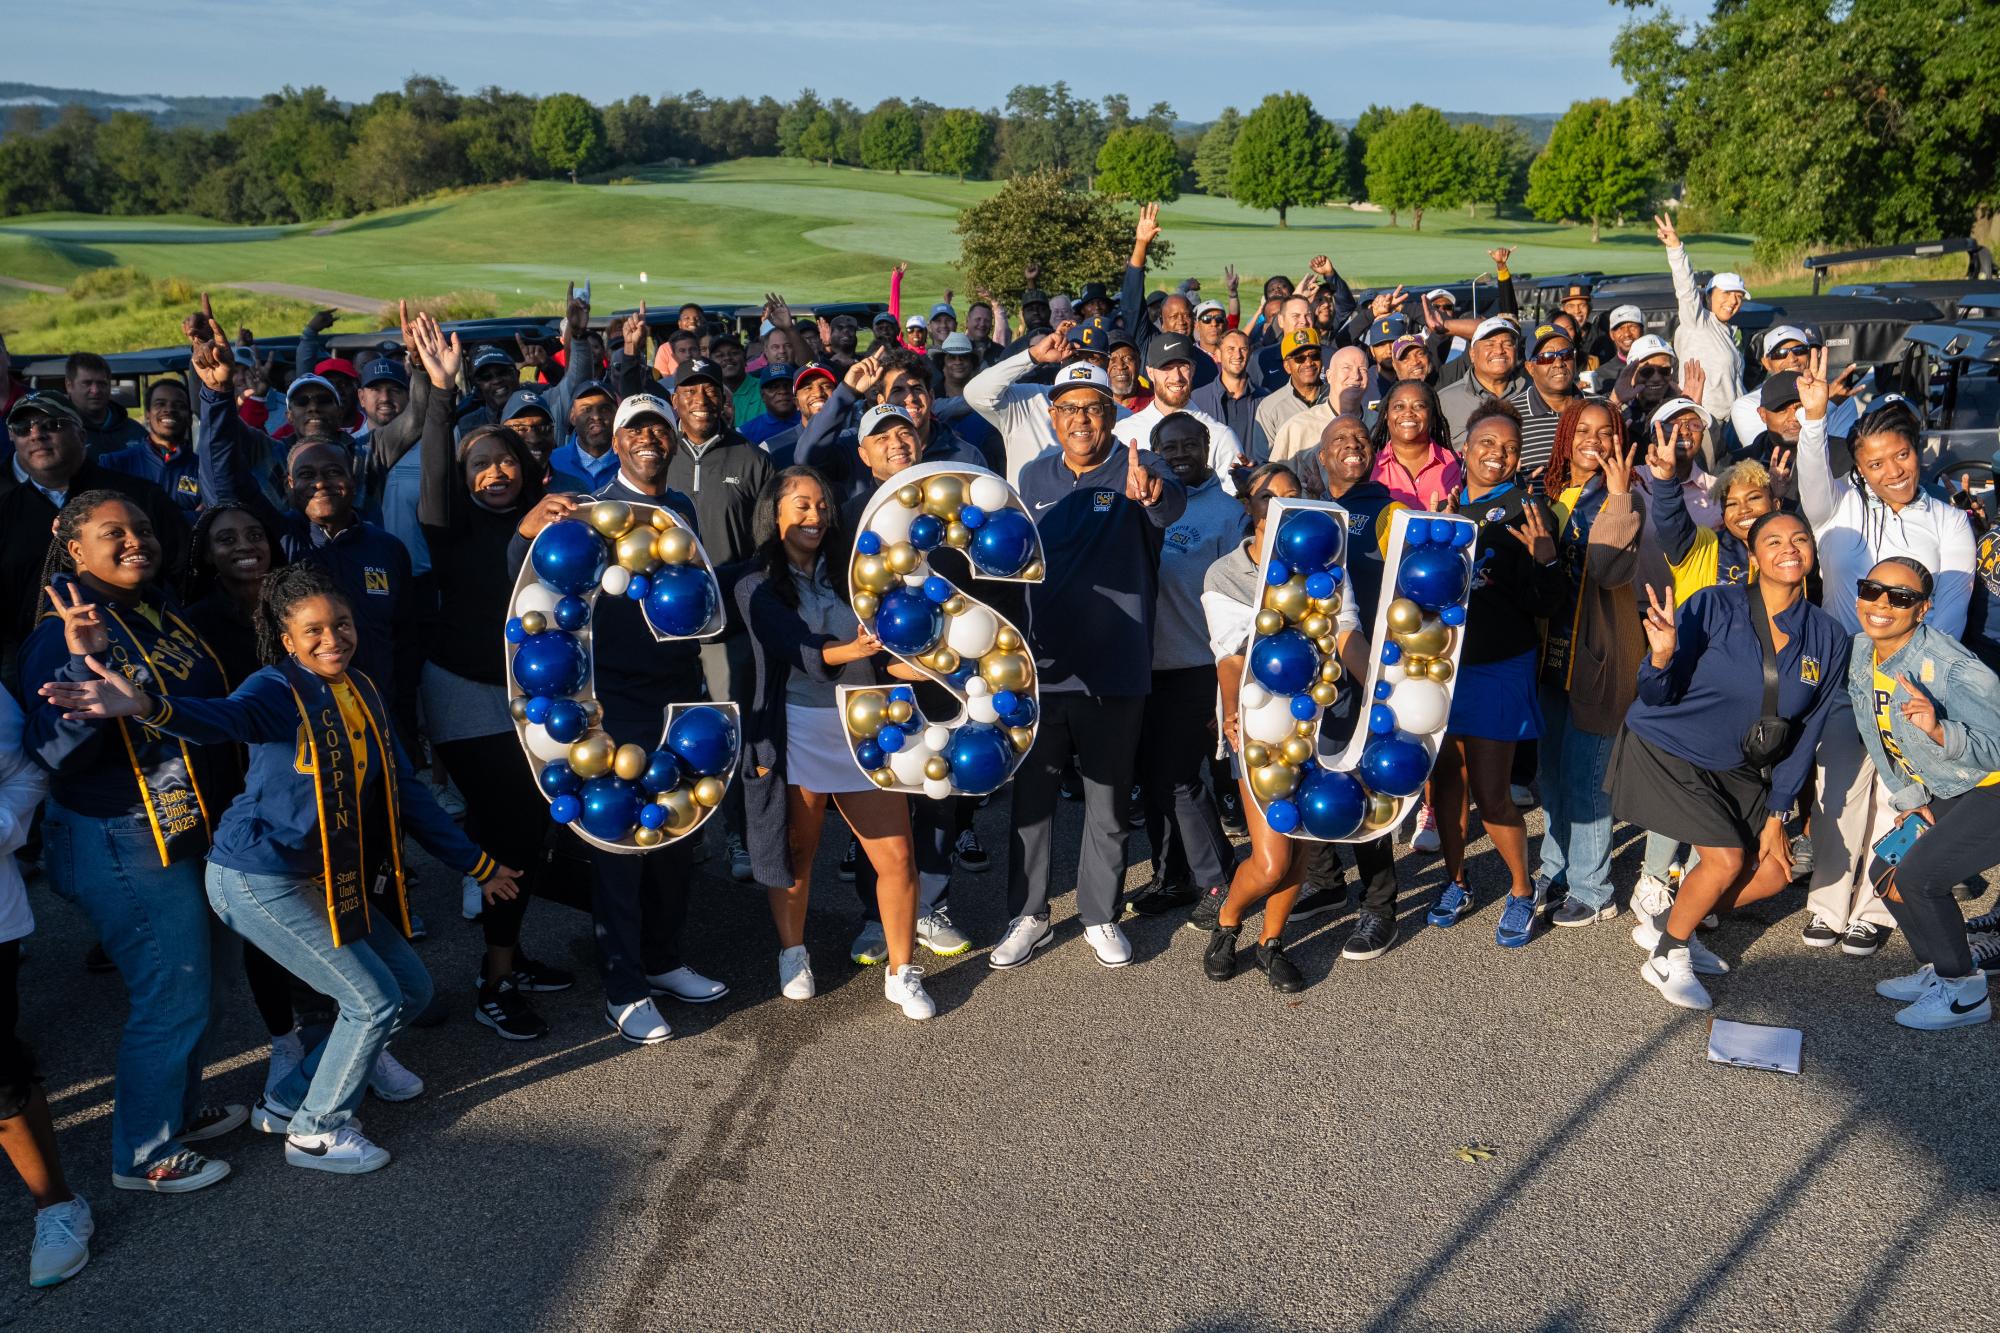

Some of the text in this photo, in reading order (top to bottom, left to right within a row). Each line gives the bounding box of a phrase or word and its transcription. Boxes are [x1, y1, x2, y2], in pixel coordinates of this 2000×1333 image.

[1082, 328, 1093, 345] C
[321, 708, 349, 830] COPPIN
[157, 788, 188, 807] State
[164, 803, 190, 820] Univ.
[167, 815, 197, 835] 2023
[336, 869, 358, 886] State
[338, 882, 358, 899] Univ.
[339, 896, 359, 914] 2023
